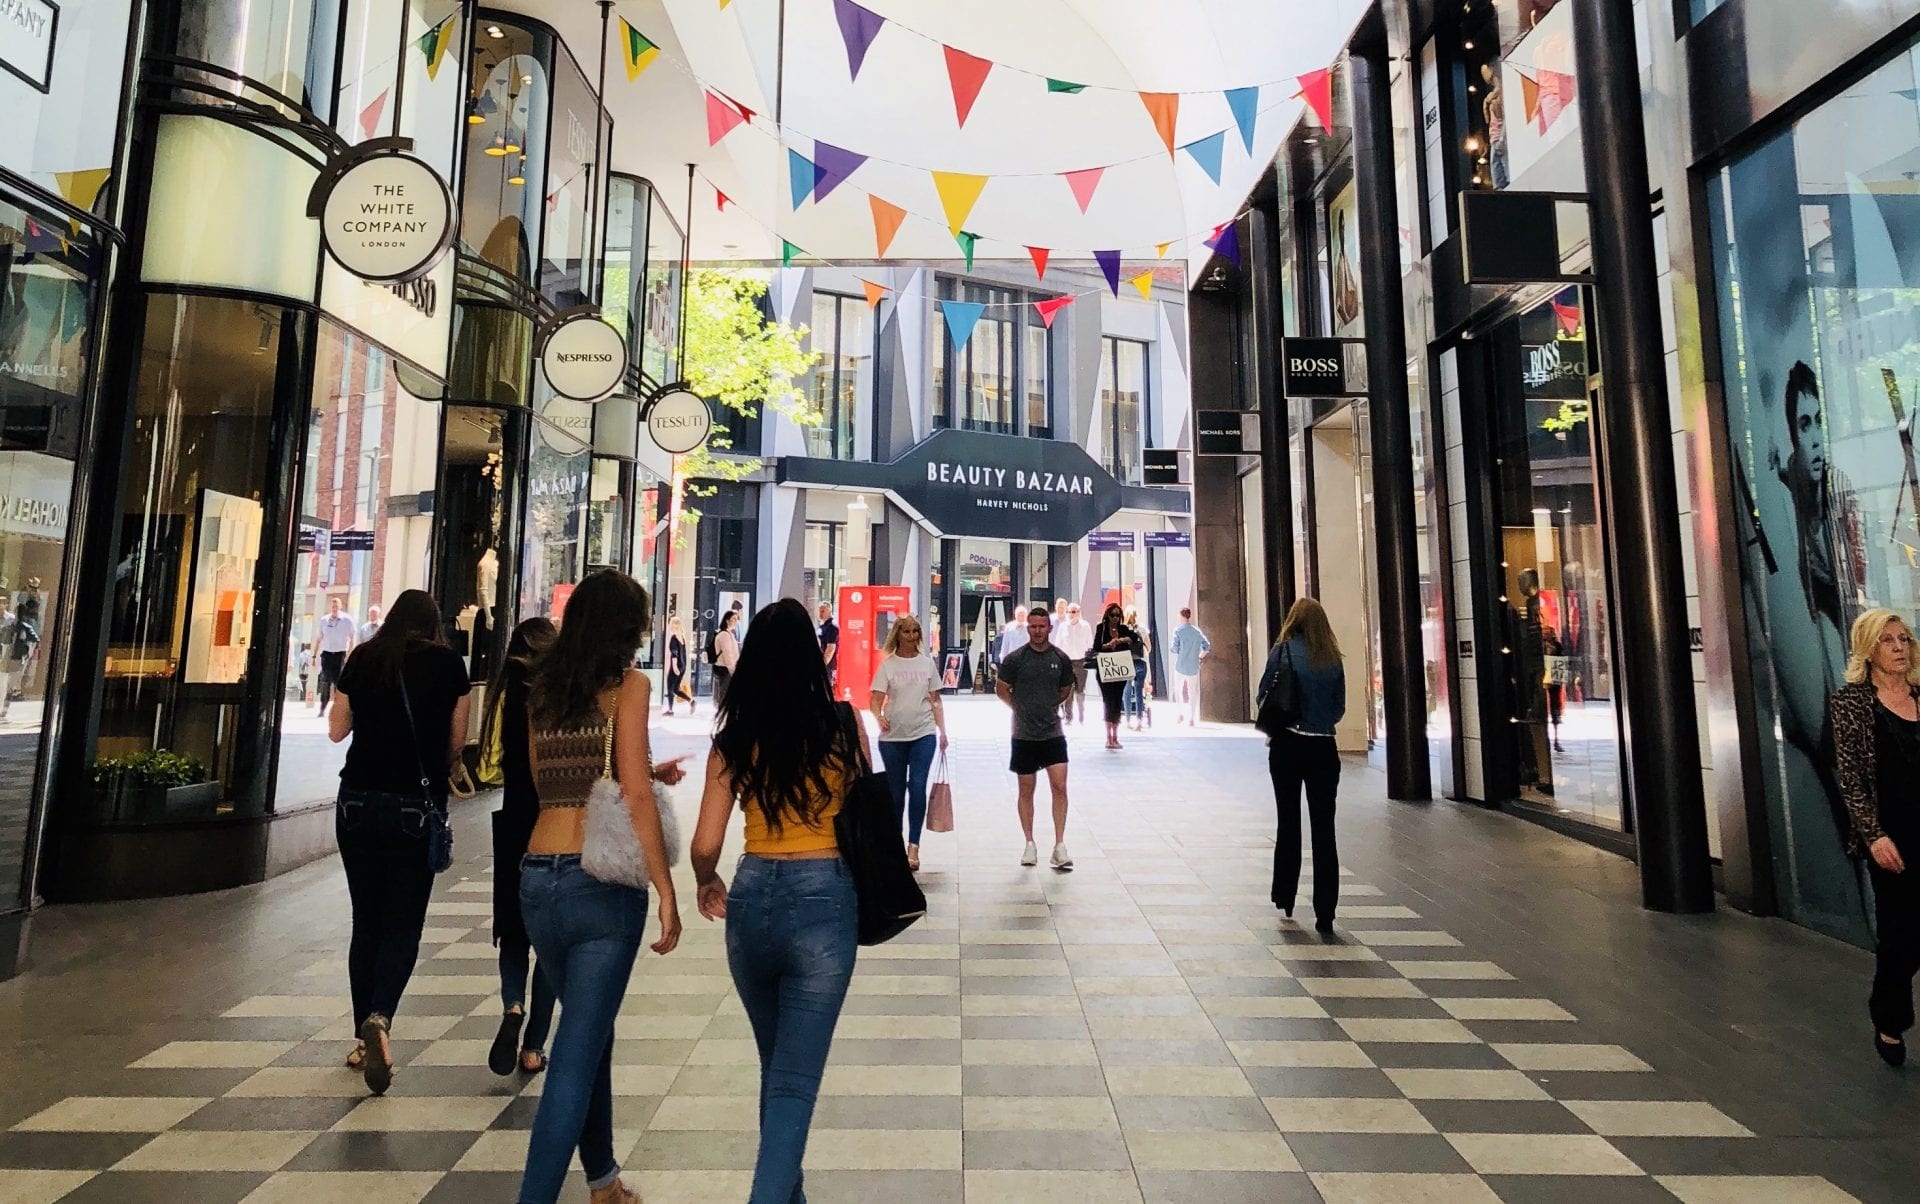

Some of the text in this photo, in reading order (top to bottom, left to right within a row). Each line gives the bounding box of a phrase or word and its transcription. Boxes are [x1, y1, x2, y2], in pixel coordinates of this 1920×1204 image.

[373, 184, 405, 196] THE
[360, 203, 415, 214] WHITE
[343, 221, 428, 233] COMPANY
[556, 352, 613, 364] NESPRESSO
[1290, 358, 1339, 373] BOSS
[655, 415, 704, 429] TESSUTI
[927, 462, 1094, 496] BEAUTY BAZAAR
[976, 498, 1049, 512] HARVEY NICHOLS
[1100, 657, 1118, 668] ISL
[1104, 665, 1130, 678] AND
